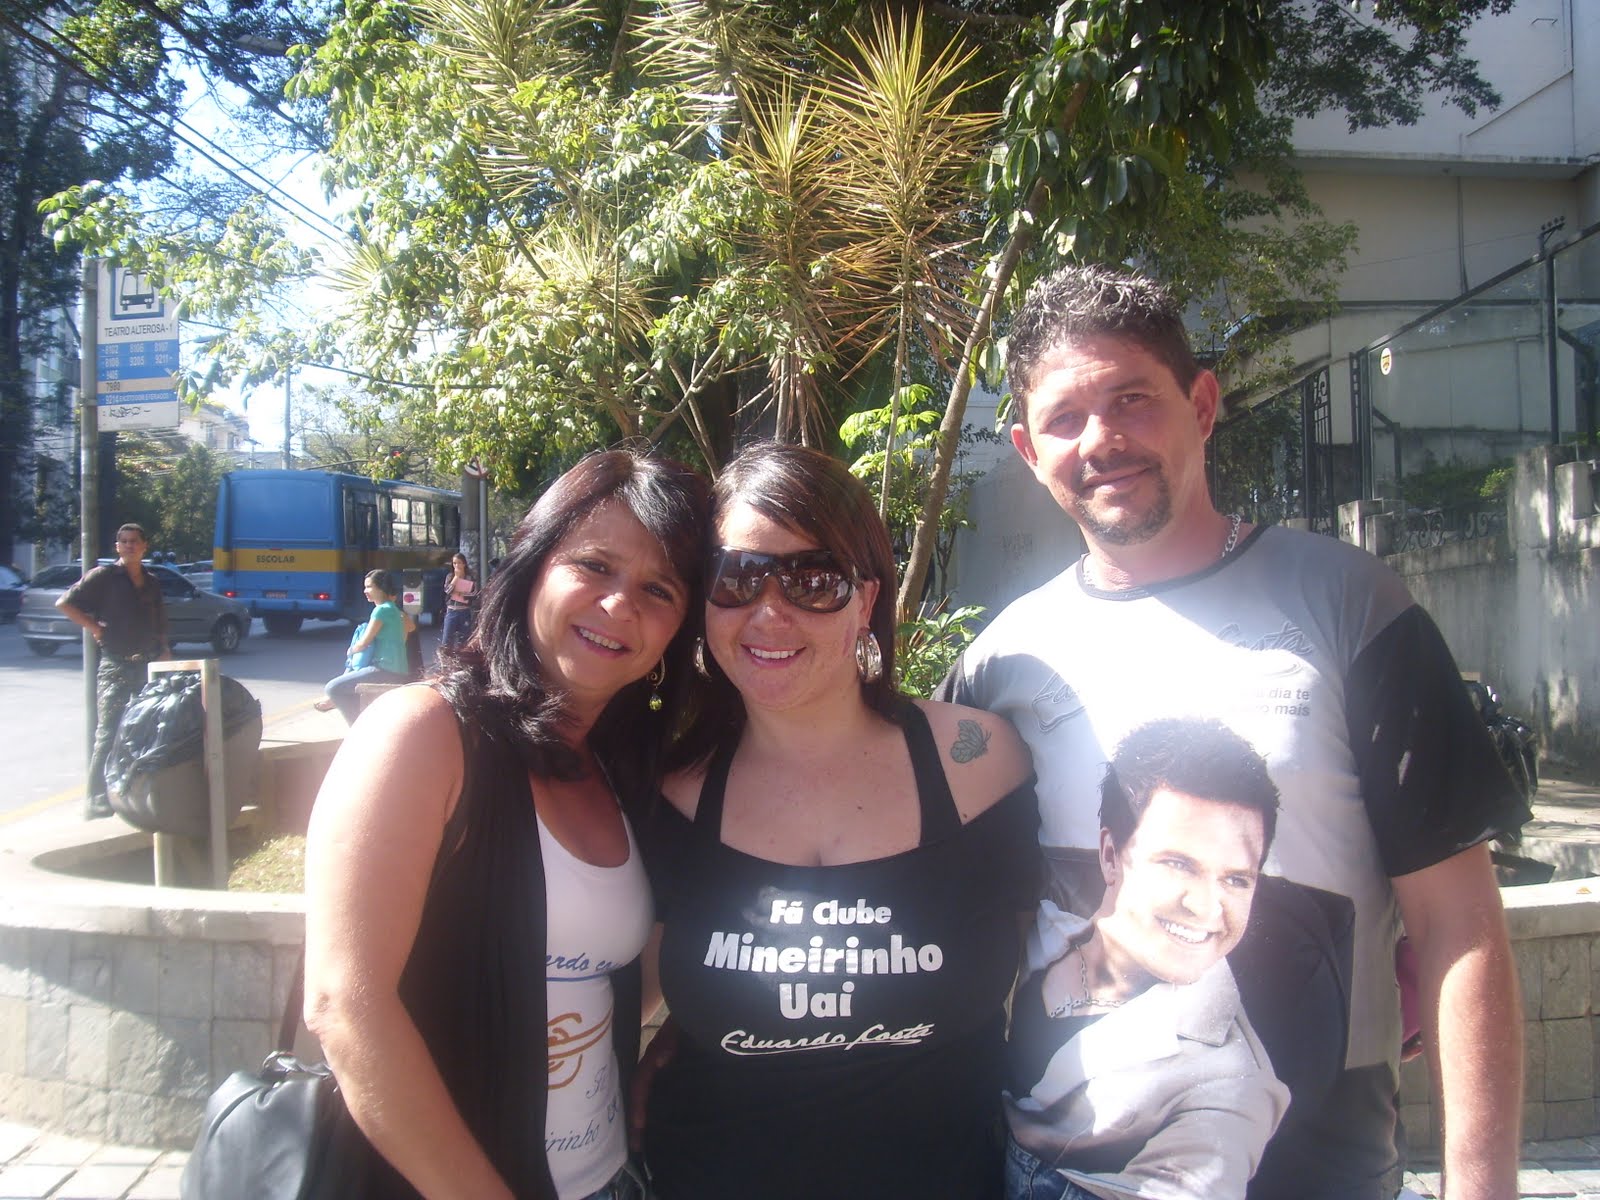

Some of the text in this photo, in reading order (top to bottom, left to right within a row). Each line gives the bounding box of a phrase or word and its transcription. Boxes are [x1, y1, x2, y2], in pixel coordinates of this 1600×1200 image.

[104, 326, 130, 337] TEATRO
[130, 323, 166, 335] ALTEROSA
[256, 555, 295, 563] ESCOLAR
[1268, 687, 1292, 698] dia
[1295, 688, 1310, 700] te
[1275, 704, 1310, 717] mais
[770, 898, 892, 925] Fã Clube
[703, 931, 944, 974] Mineirinho
[779, 981, 855, 1020] Uai
[720, 1023, 935, 1056] Eduardo Costa
